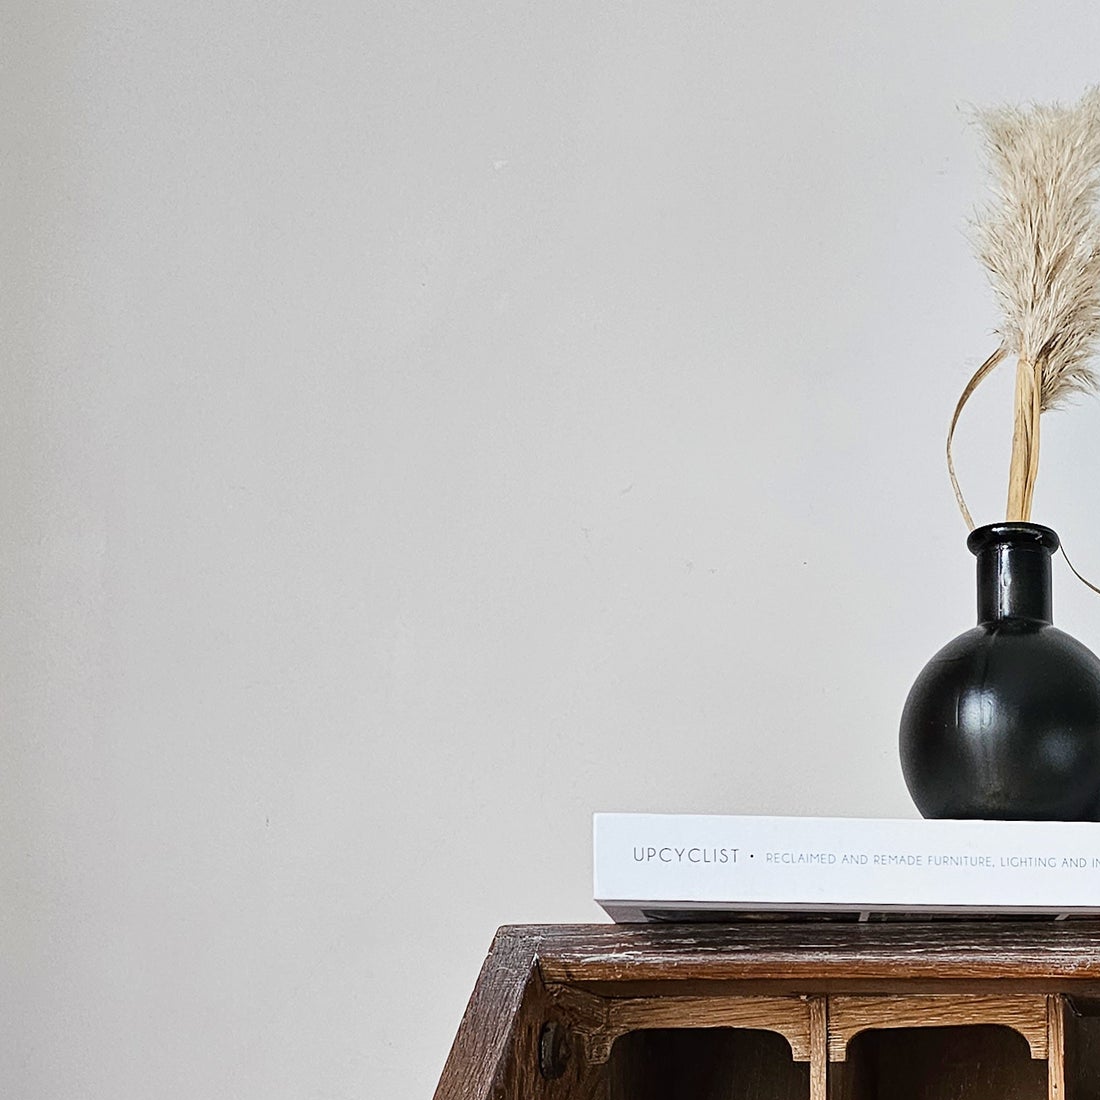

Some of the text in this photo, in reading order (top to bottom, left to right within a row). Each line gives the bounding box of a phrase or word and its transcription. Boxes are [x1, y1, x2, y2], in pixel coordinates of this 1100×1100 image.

[633, 846, 740, 864] UPCYCLIST
[765, 852, 837, 864] RECLAIMED
[841, 854, 869, 865] AND
[873, 854, 923, 866] REMADE
[927, 855, 996, 868] FURNITURE,
[1000, 856, 1057, 868] LIGHTING
[1061, 857, 1088, 868] AND
